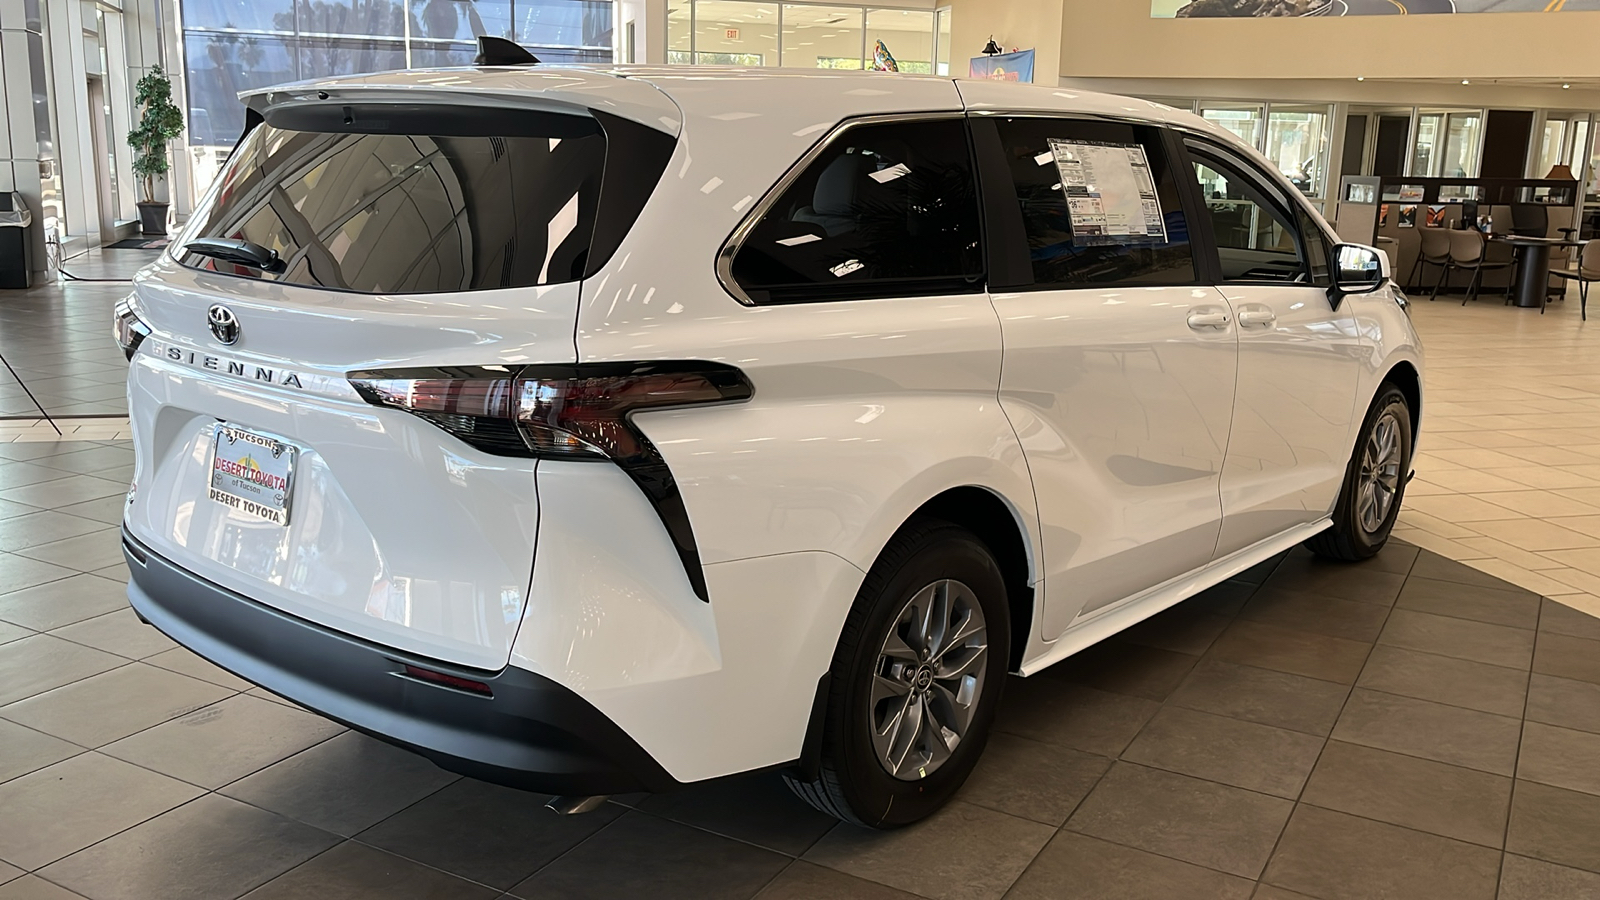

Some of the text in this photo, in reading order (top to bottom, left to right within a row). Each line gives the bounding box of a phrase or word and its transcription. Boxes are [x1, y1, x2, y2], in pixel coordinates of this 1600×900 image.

[727, 30, 737, 39] EXIT
[167, 347, 303, 389] SIENNA
[233, 430, 273, 448] TUCSON
[215, 457, 286, 492] DESERT TOYOTA
[232, 479, 261, 495] of Tucson
[209, 489, 280, 523] DESERT TOYOTA
